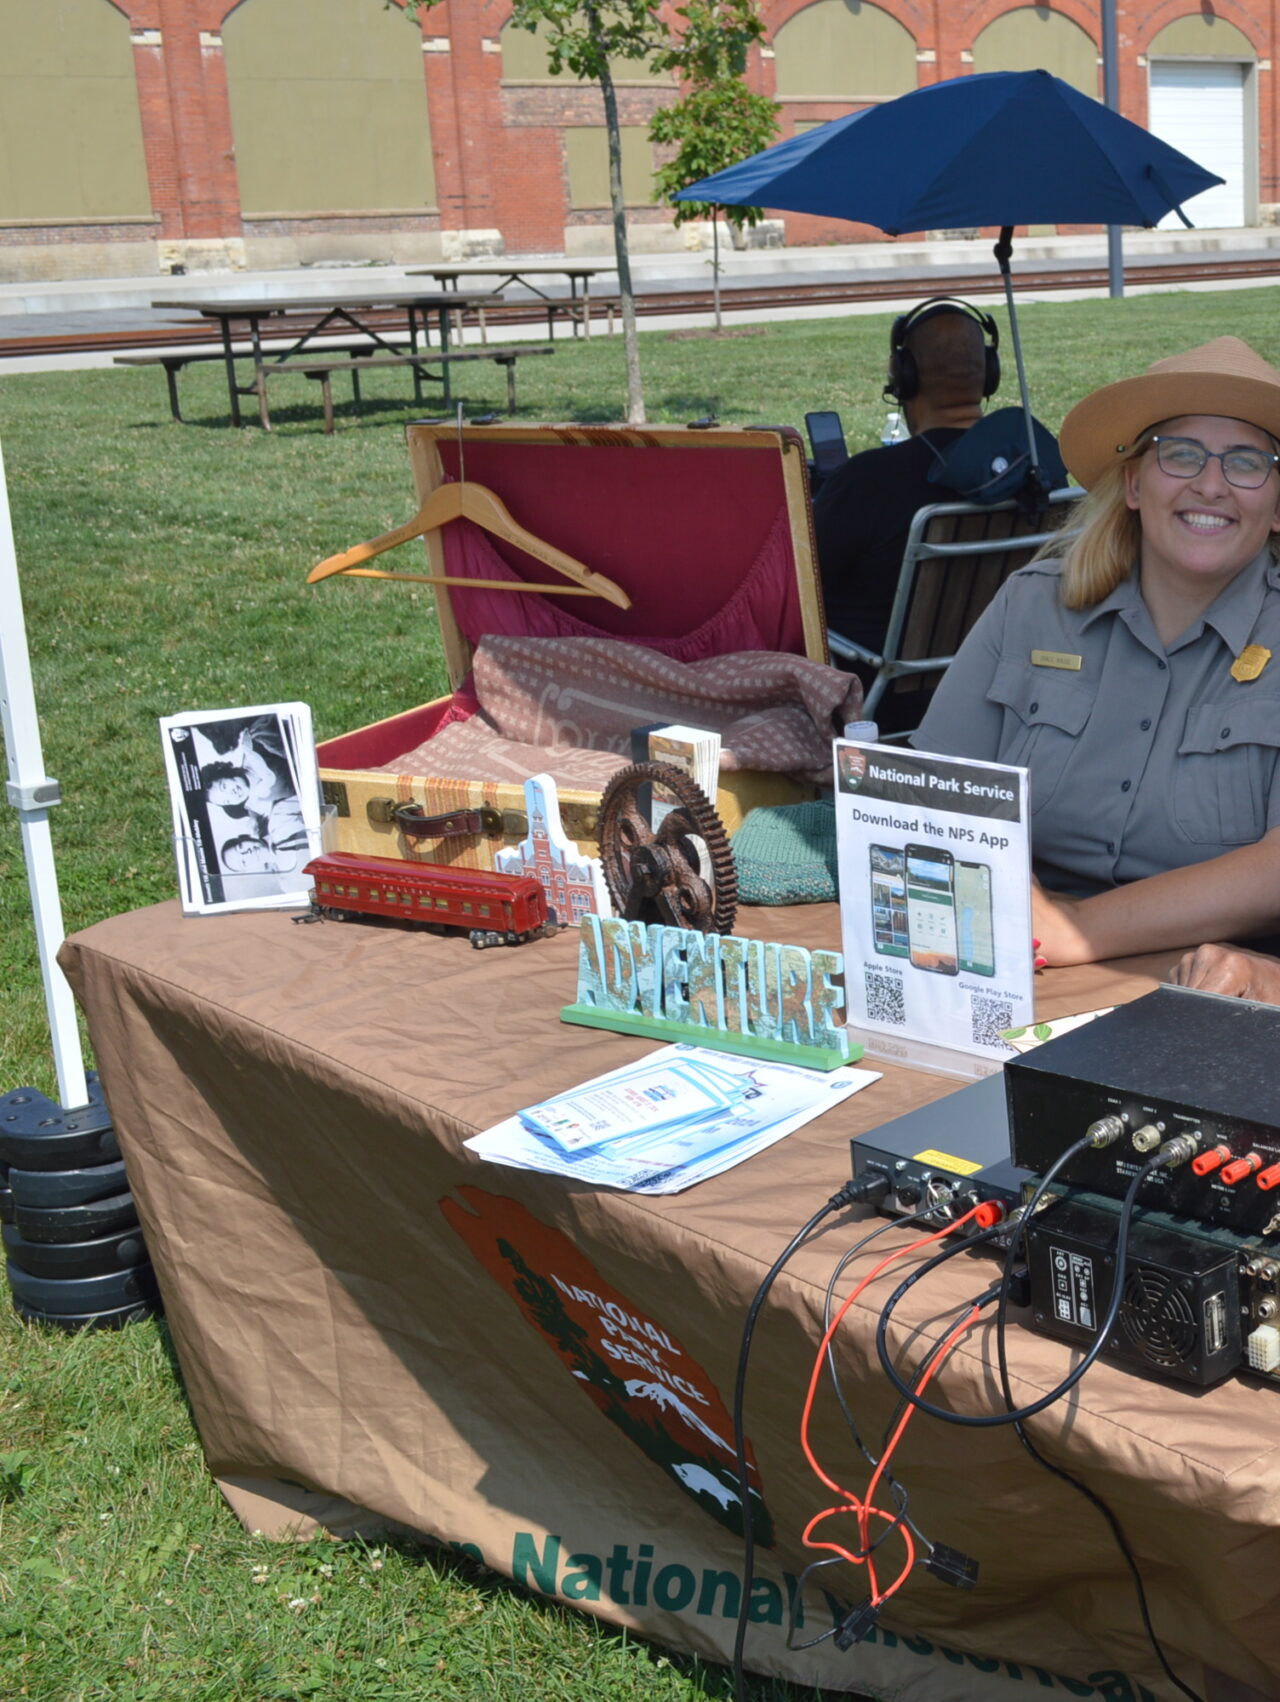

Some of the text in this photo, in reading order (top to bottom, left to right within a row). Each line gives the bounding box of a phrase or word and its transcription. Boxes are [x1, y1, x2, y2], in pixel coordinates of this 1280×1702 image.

[868, 765, 925, 788] National
[929, 775, 960, 793] Park
[963, 780, 1014, 801] Service
[852, 808, 1009, 850] Download the NPS App
[577, 913, 849, 1059] ADVENTURE
[863, 961, 903, 975] Apple Store
[959, 981, 1023, 1001] Google Play Store
[550, 1273, 681, 1356] NATIONAL
[601, 1338, 710, 1405] SERVICE
[512, 1532, 804, 1629] National
